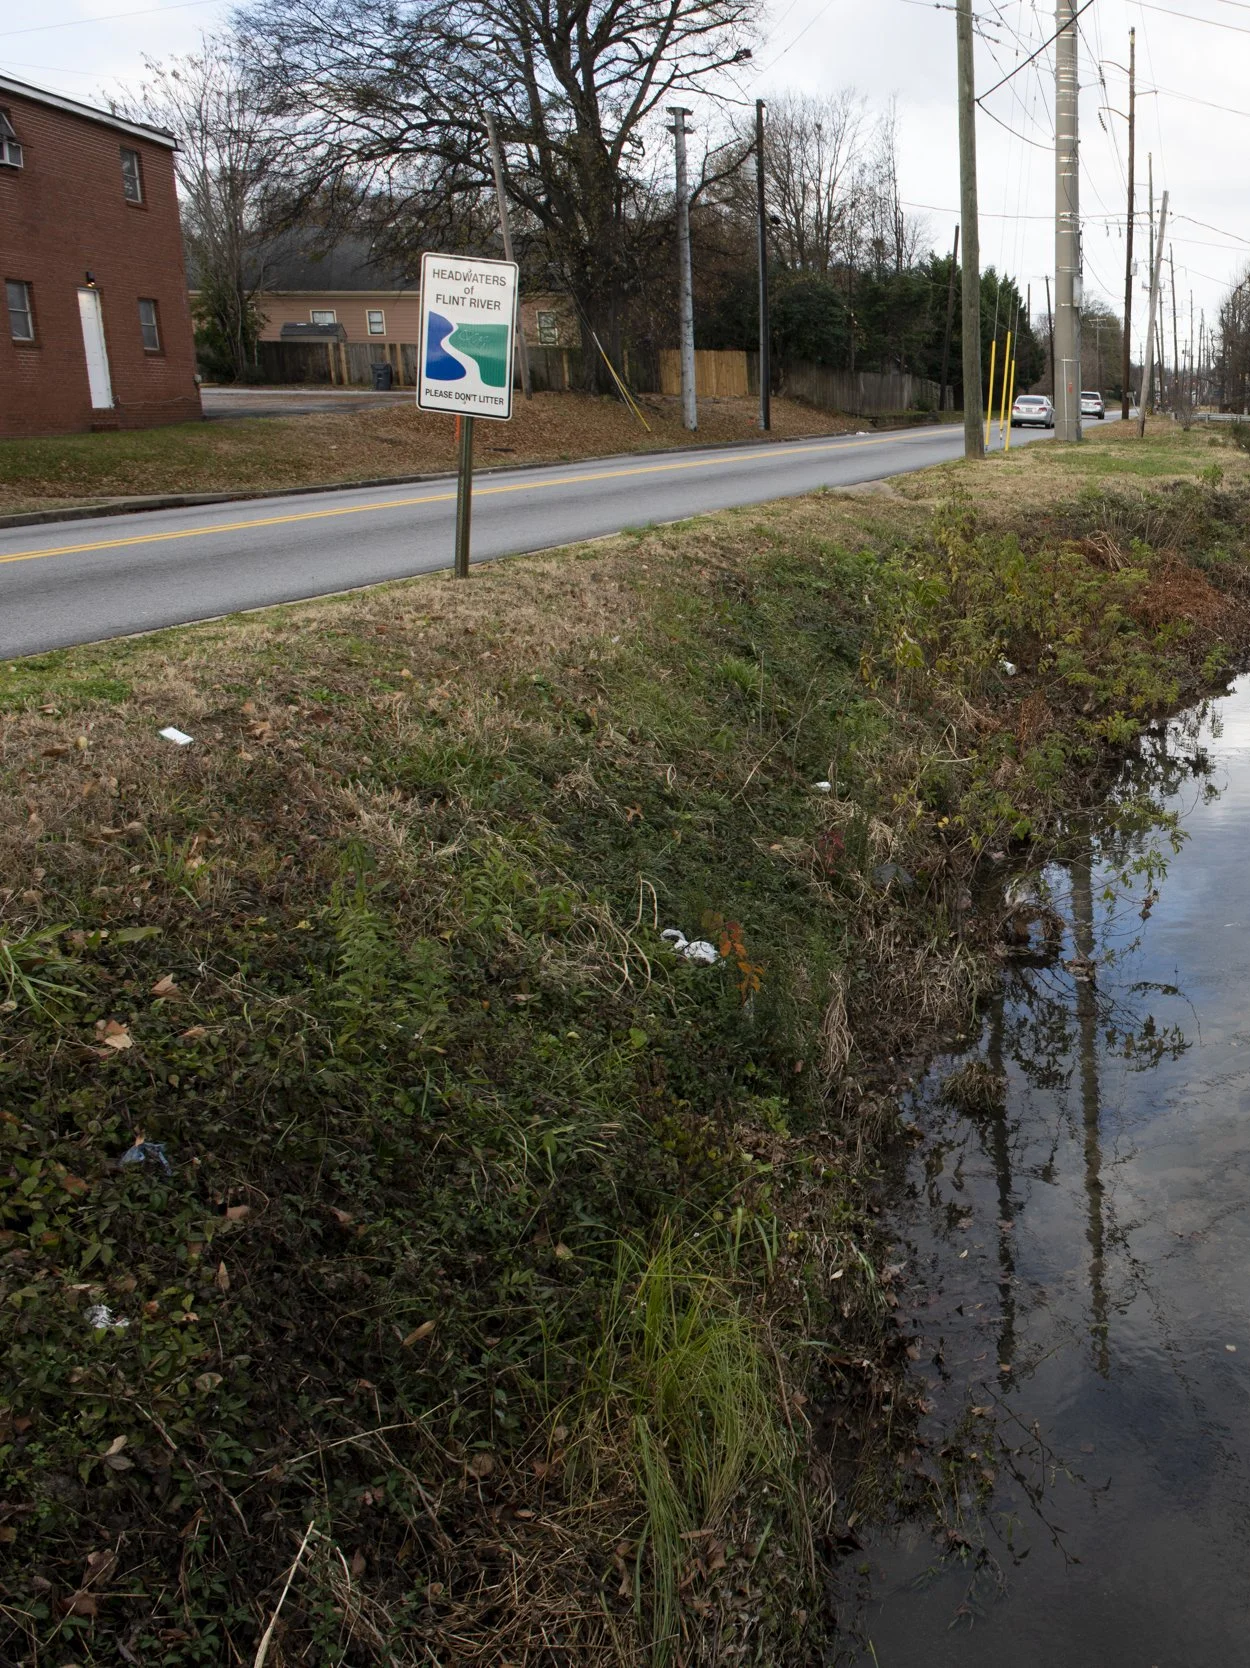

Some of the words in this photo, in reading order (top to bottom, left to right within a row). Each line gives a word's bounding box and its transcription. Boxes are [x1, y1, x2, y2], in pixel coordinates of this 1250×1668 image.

[432, 269, 507, 287] HEADWATERS
[464, 285, 475, 295] of
[435, 294, 467, 307] FLINT
[469, 298, 501, 310] RIVER
[425, 388, 453, 400] PLEASE
[454, 392, 477, 402] DON'T
[478, 395, 504, 406] LITTER
